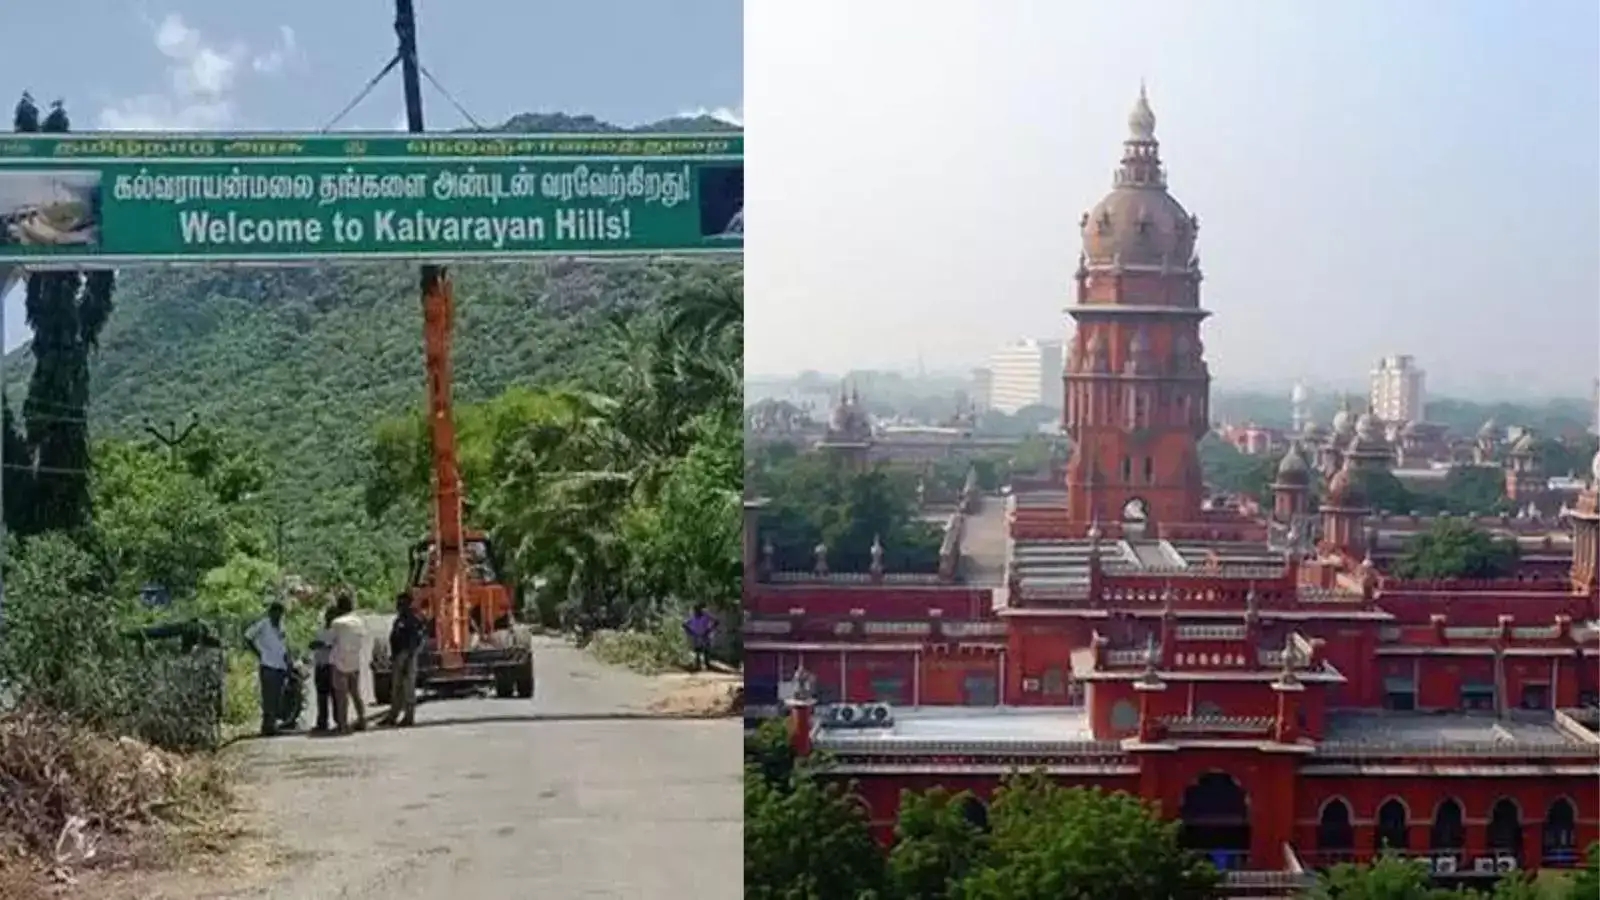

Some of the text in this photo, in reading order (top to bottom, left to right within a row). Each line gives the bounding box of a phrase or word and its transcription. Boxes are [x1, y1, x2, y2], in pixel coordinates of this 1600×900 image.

[113, 165, 690, 207] கல்வராயன்மலை தங்களை அன்புடன் வரவேற்கிறது!
[179, 208, 632, 247] Welcome to Kalvarayan Hills!
